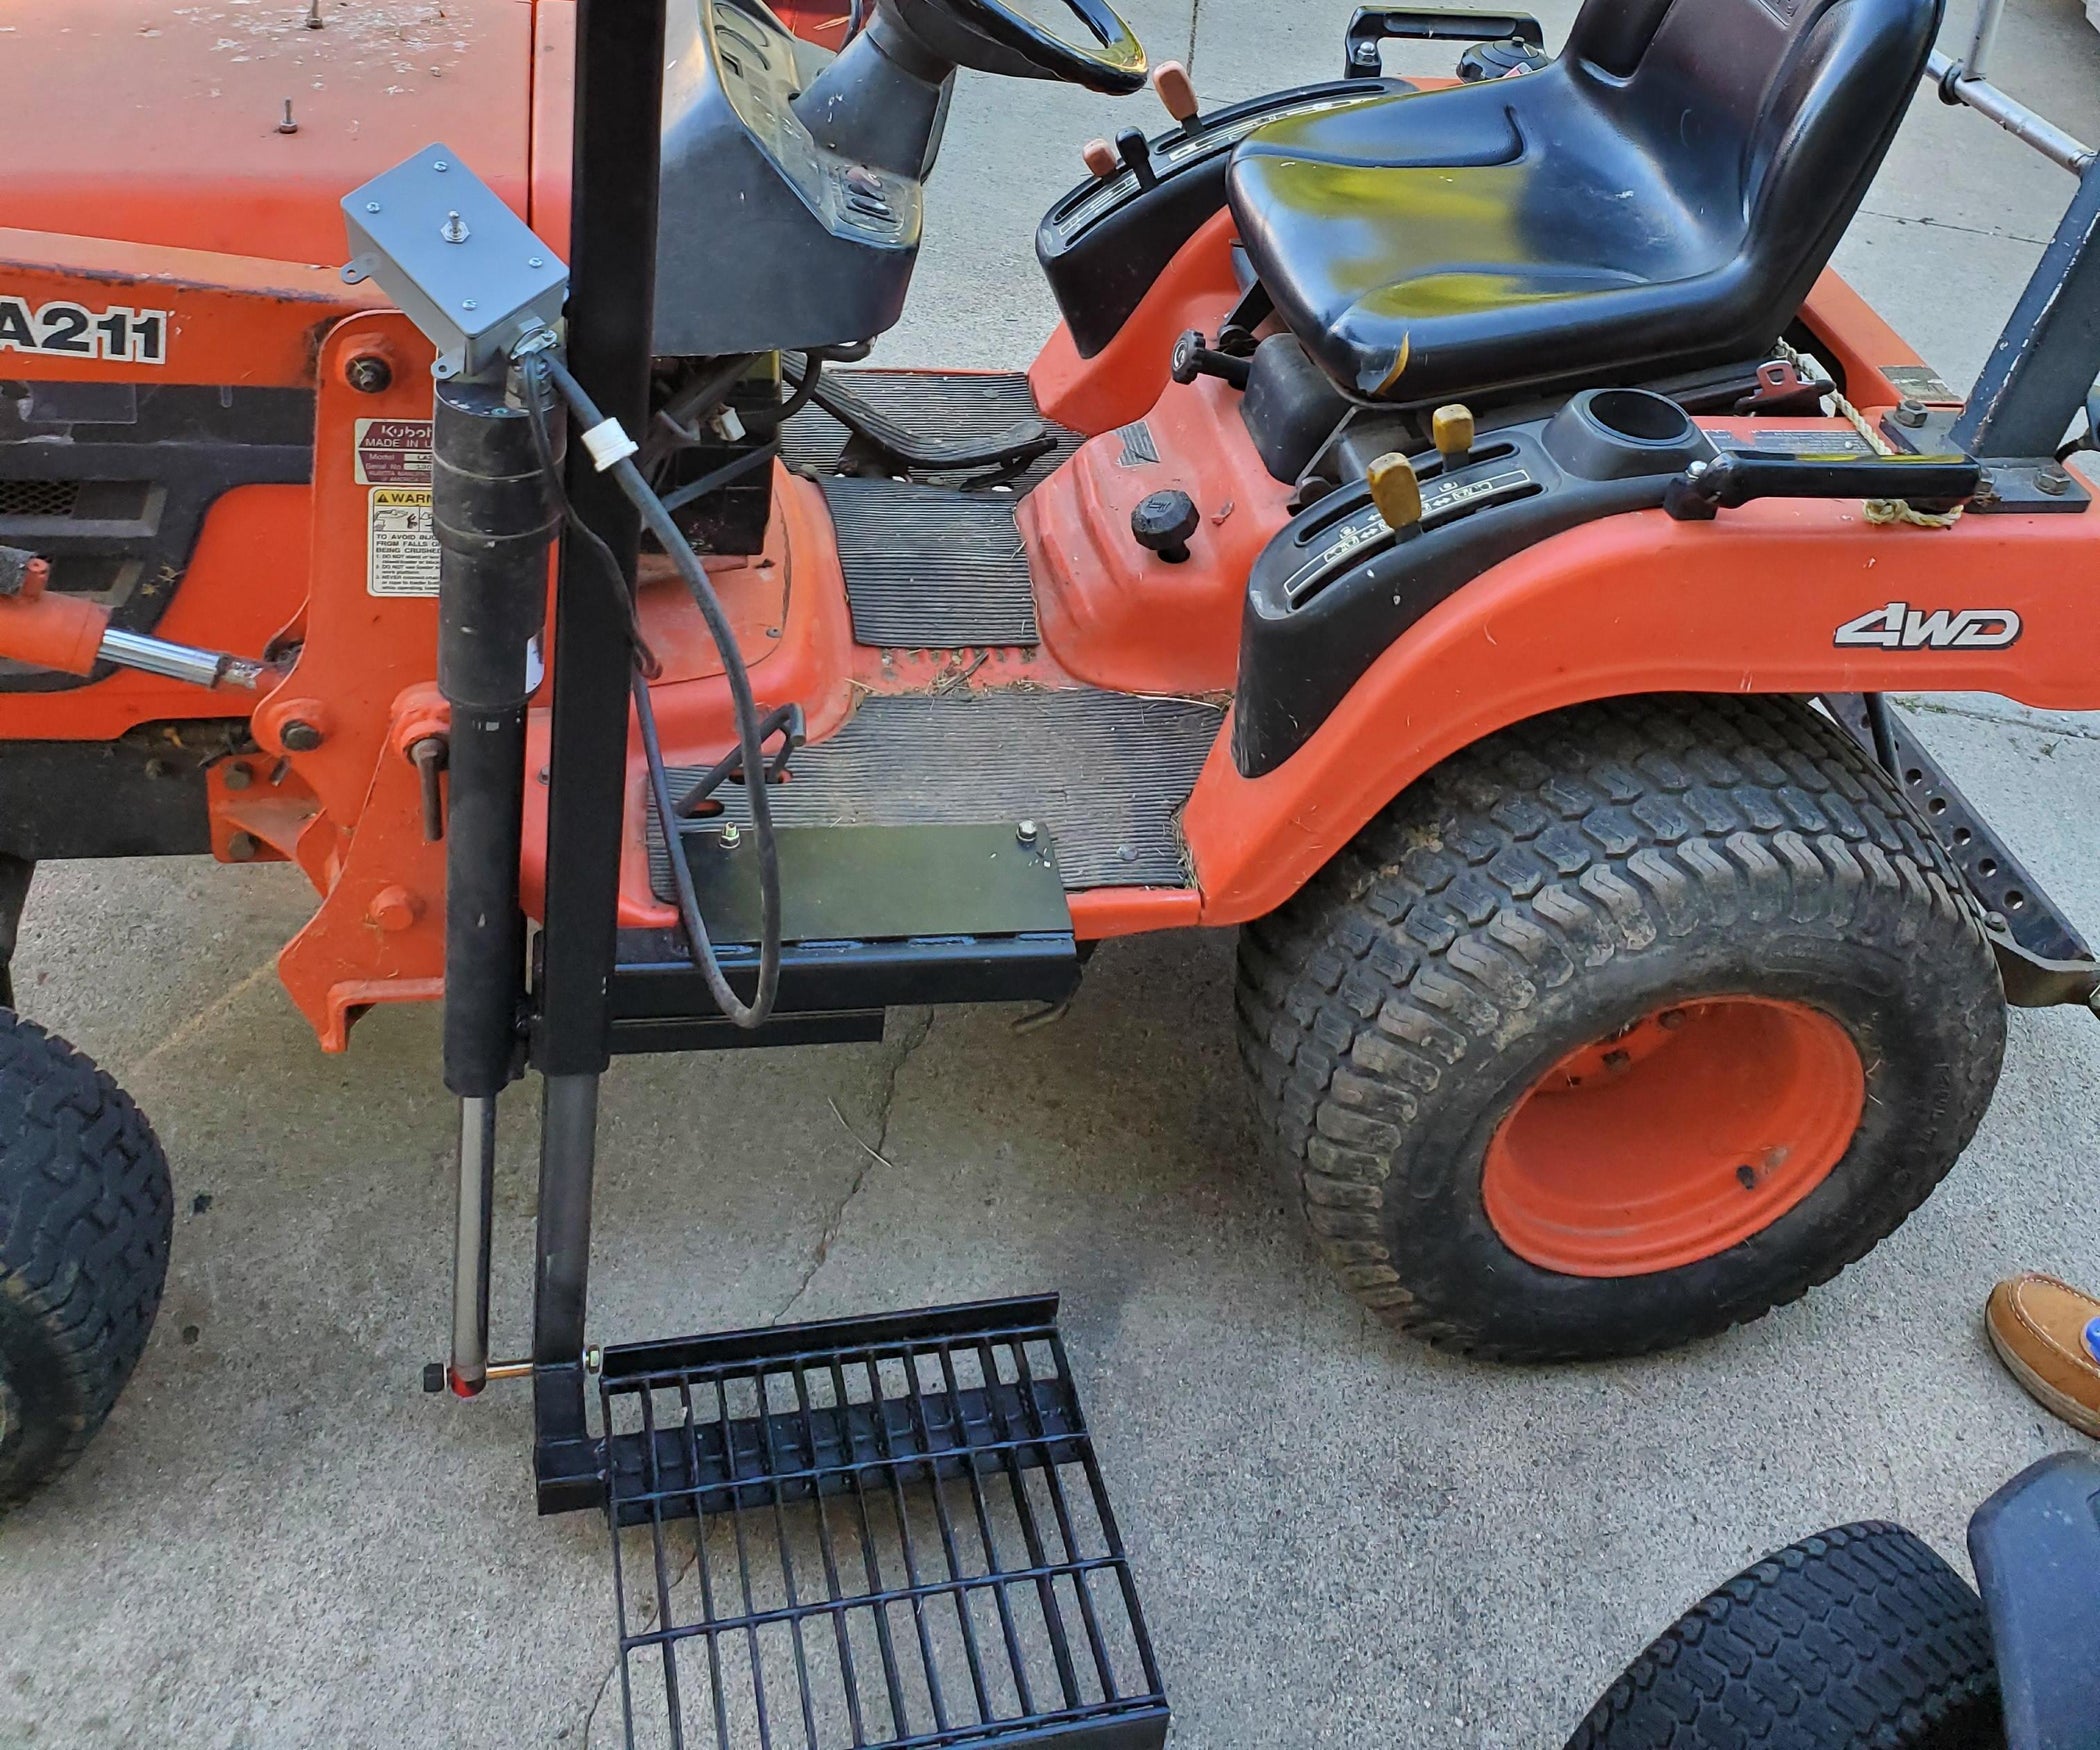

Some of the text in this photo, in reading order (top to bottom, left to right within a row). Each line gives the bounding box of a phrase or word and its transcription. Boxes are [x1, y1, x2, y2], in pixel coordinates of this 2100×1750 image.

[365, 438, 400, 447] MADE
[406, 440, 418, 448] IN
[1834, 602, 2021, 649] 4WD
